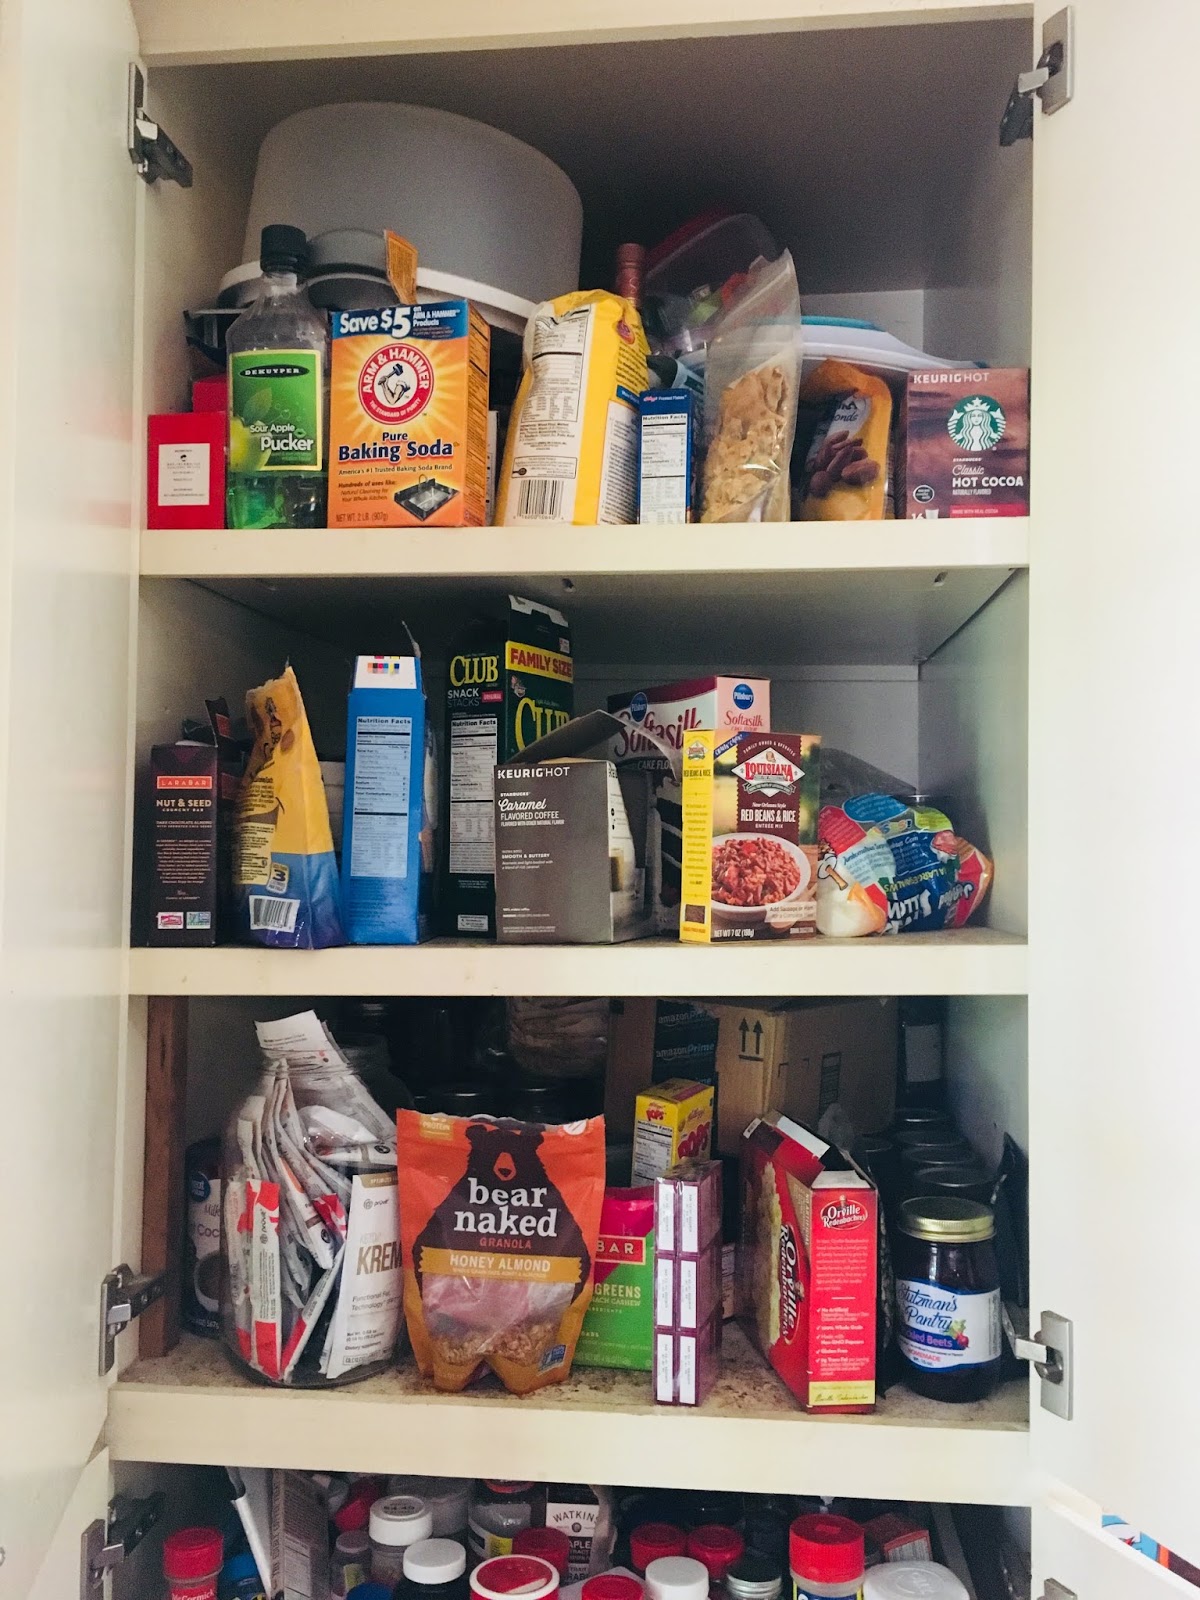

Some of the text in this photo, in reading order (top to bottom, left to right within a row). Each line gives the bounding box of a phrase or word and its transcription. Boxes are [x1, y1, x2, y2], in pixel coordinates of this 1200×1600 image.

[339, 313, 379, 334] Save
[380, 306, 411, 338] $5
[245, 368, 300, 376] DEKUYPER
[362, 347, 429, 394] ARM & HAMMER
[249, 423, 296, 434] Sour Apple
[260, 433, 314, 451] Pucker
[382, 432, 408, 442] Pure
[338, 439, 453, 463] Baking Soda
[952, 465, 984, 476] Classic
[952, 476, 1024, 487] HOT COCOA
[336, 513, 346, 522] NET
[510, 647, 573, 677] FAMILY SIZE
[450, 655, 499, 687] CLUB
[447, 688, 479, 699] SNACK
[733, 692, 754, 703] Pillsbury
[447, 698, 480, 708] STACKS
[724, 710, 764, 726] Softasilk
[637, 759, 672, 770] CAKE FLO
[744, 762, 794, 782] LOUISIANA
[156, 798, 212, 807] NUT & SEED
[498, 798, 547, 812] Caramel
[501, 810, 559, 820] FLAVORED COFFEE
[740, 808, 796, 823] RED BEANS & RICE
[272, 869, 286, 881] 3
[422, 1121, 450, 1131] PROTEIN
[467, 1177, 548, 1208] bear
[828, 1204, 861, 1219] Orville
[453, 1206, 558, 1237] naked
[197, 1223, 220, 1238] Coc
[479, 1238, 532, 1250] GRANOLA
[450, 1254, 551, 1273] HONEY ALMOND
[594, 1282, 642, 1298] GREENS
[785, 1241, 797, 1329] Orville
[610, 1298, 641, 1307] CASHEW
[905, 1305, 953, 1333] Pantry
[926, 1335, 953, 1347] Beets
[553, 1510, 598, 1524] WATKIN
[569, 1540, 591, 1549] APLE
[172, 1589, 215, 1600] McCormick
